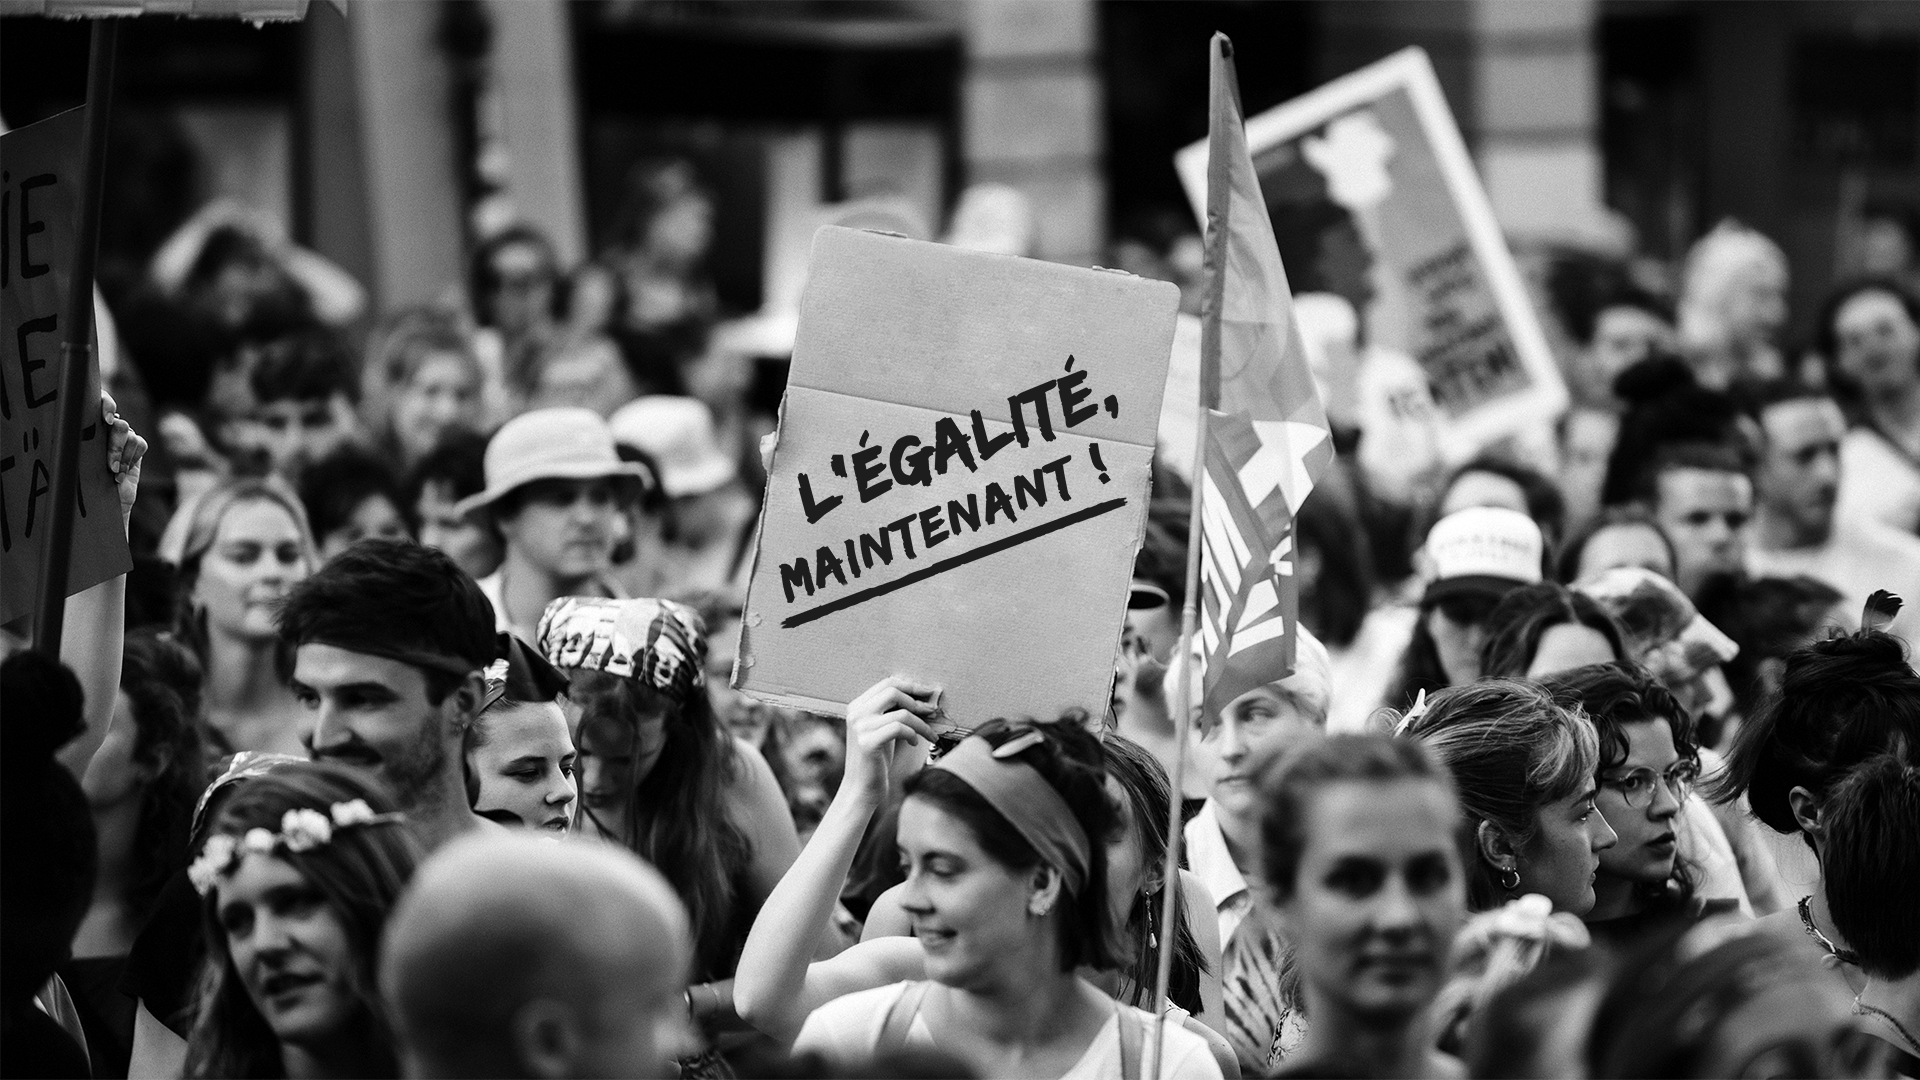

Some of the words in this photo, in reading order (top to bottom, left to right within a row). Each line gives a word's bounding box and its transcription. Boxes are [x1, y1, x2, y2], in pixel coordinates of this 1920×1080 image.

[0, 313, 58, 420] E
[797, 354, 1119, 524] L'ÉGALITÉ,
[779, 455, 1072, 603] MAINTENANT
[1088, 443, 1111, 484] !
